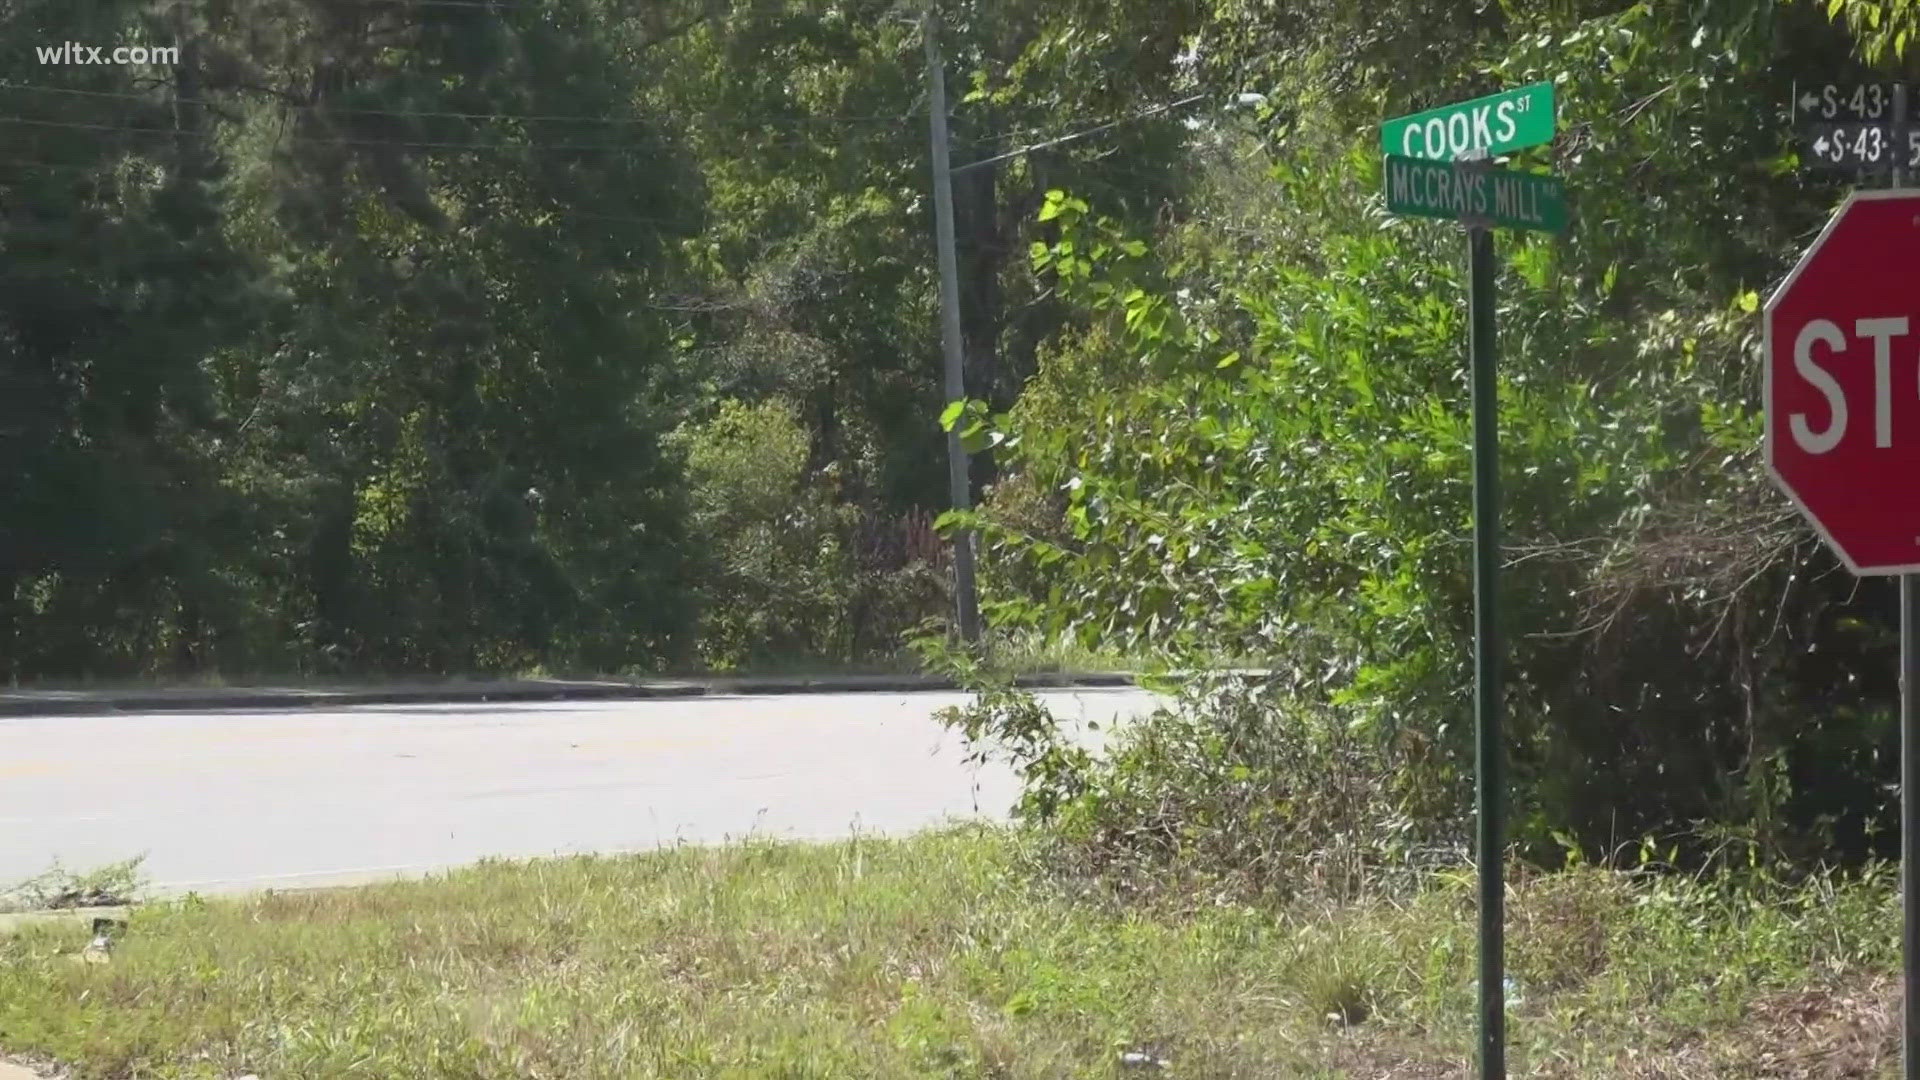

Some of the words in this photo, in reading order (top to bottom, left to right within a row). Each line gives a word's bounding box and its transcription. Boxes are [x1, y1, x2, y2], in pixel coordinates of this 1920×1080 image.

[1402, 100, 1516, 160] COOKS
[1517, 95, 1531, 112] ST
[1392, 163, 1487, 214] MCCRAYS
[1494, 178, 1543, 222] MILL
[1789, 316, 1920, 454] ST
